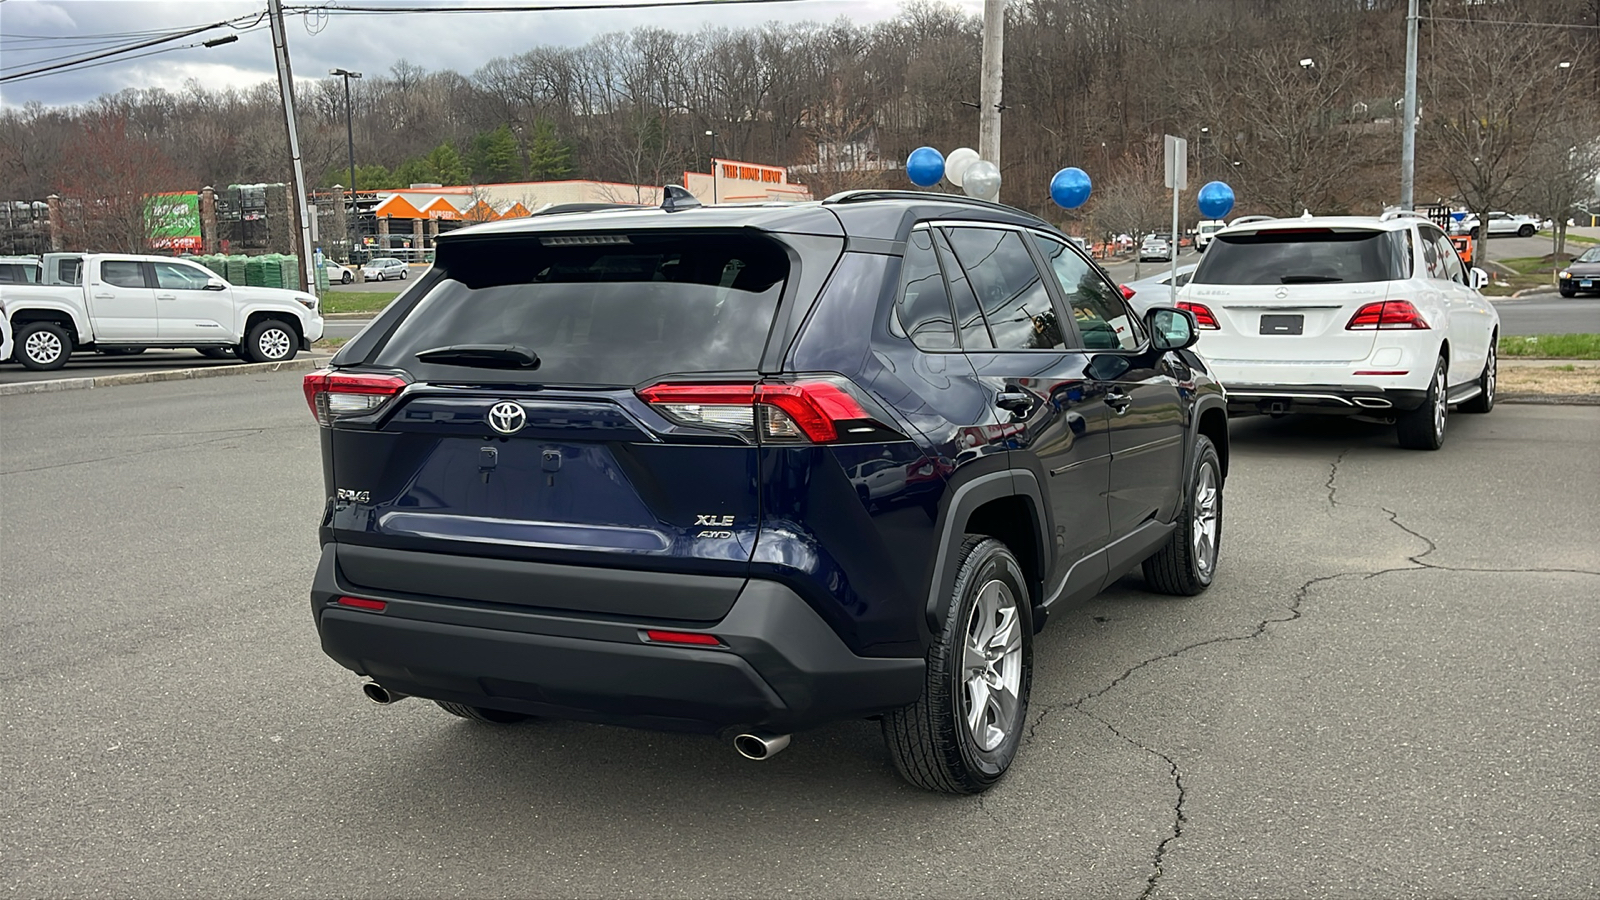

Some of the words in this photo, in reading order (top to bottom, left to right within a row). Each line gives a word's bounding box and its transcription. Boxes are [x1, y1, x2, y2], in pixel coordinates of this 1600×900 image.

[722, 164, 738, 178] THE
[739, 166, 760, 181] HOME
[761, 168, 782, 183] DEPOT
[147, 217, 197, 229] TCHENS
[337, 488, 370, 503] RAV4
[694, 515, 735, 526] XLE
[696, 530, 732, 539] AWD
